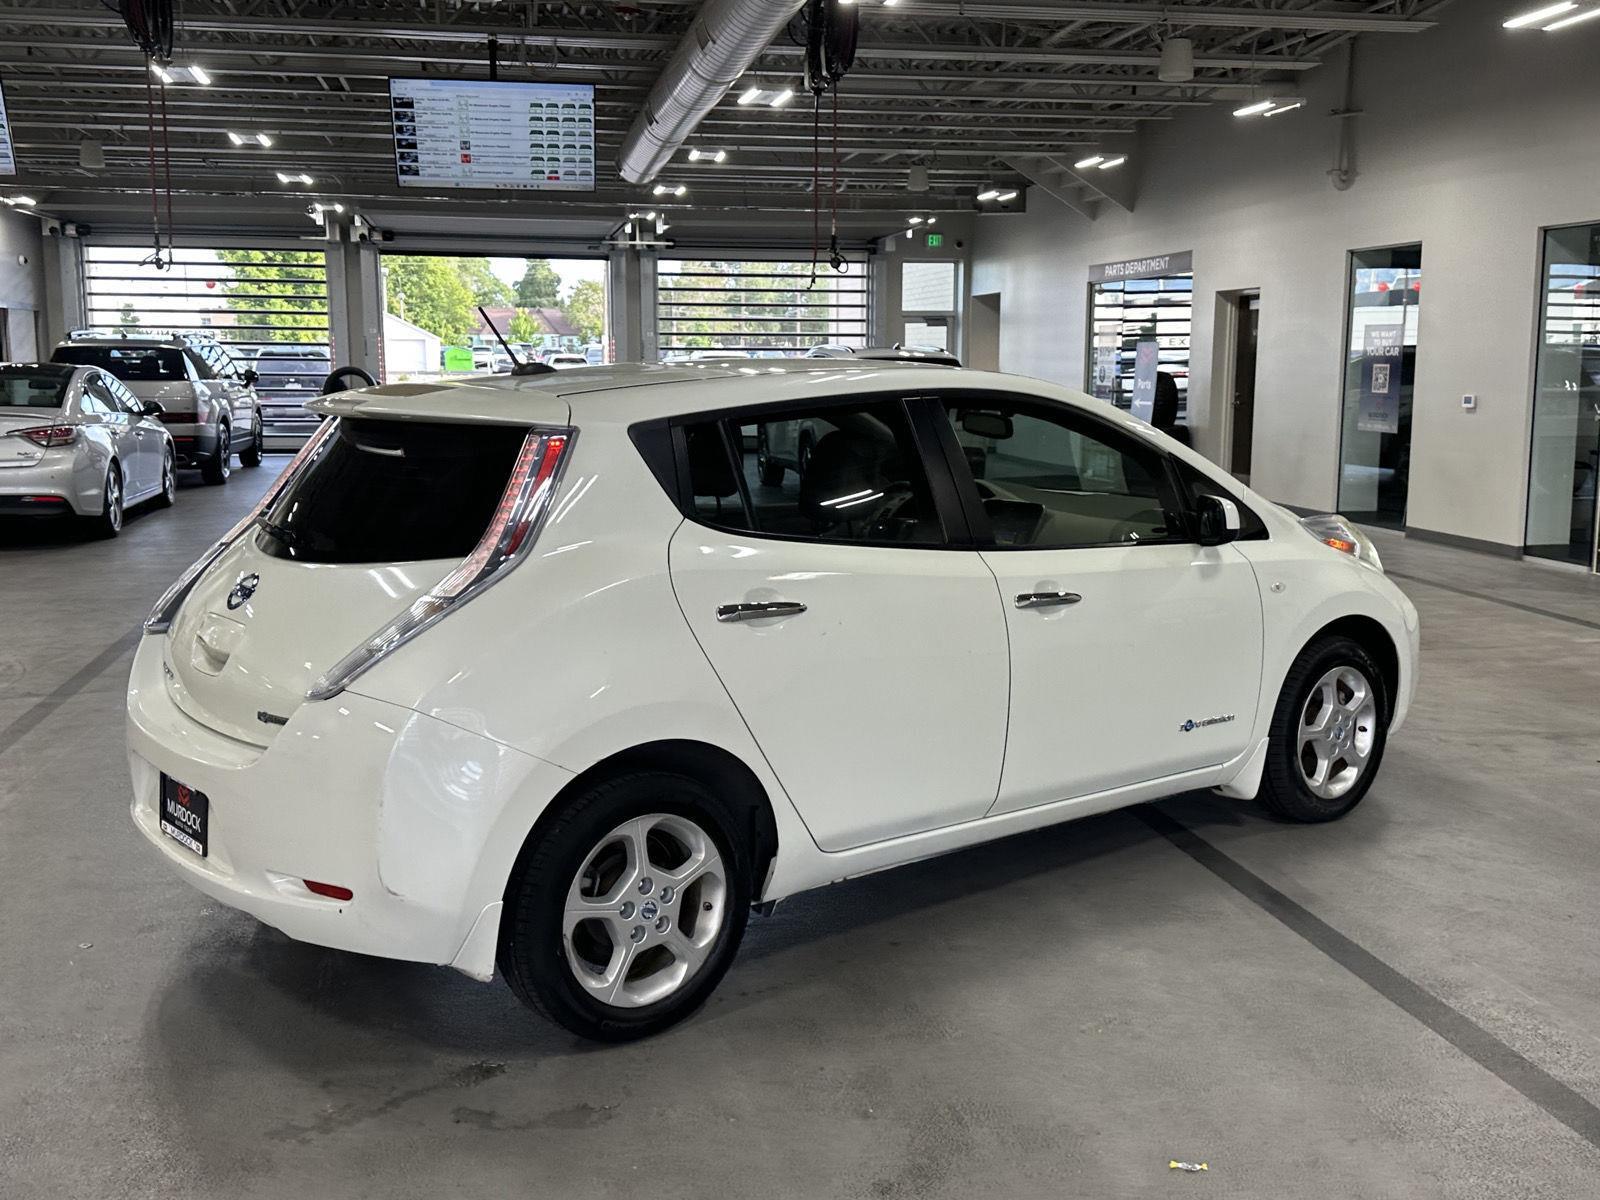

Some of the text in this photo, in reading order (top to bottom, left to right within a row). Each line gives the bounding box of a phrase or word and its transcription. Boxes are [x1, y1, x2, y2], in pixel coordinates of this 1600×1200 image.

[1104, 256, 1169, 277] PARTS DEPARTMENT
[1366, 346, 1399, 356] YOUR CAR
[167, 798, 201, 832] MURDOCK
